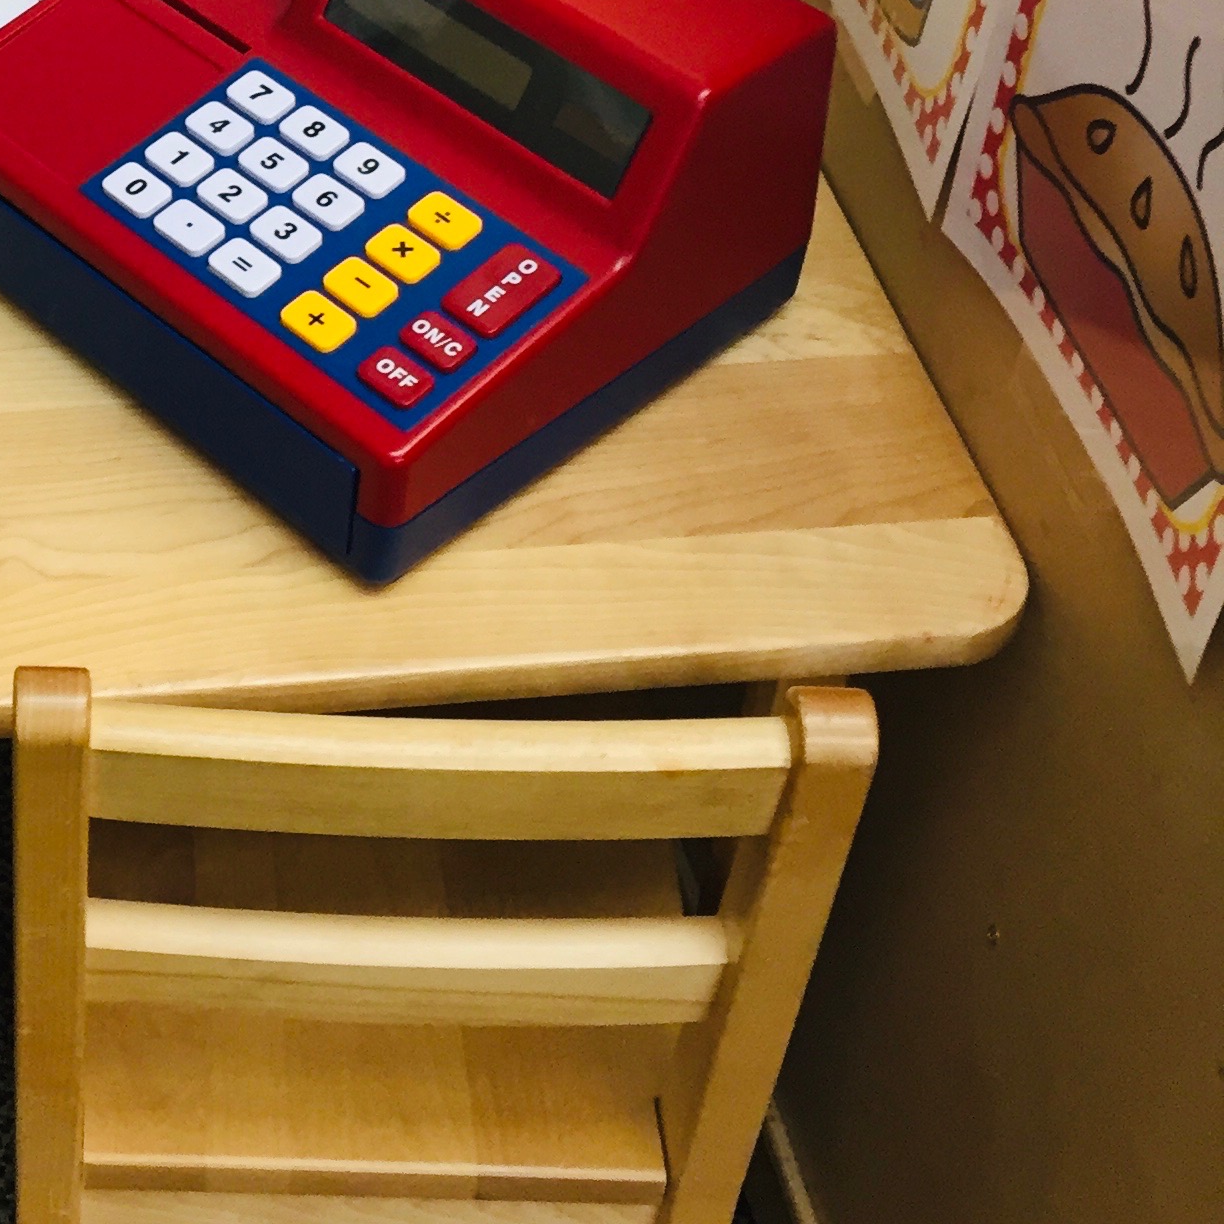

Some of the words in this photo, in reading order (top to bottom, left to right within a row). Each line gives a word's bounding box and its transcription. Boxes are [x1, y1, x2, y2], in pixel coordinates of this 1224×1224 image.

[249, 84, 274, 100] 7
[209, 119, 231, 134] 4
[302, 120, 326, 138] 8
[170, 150, 190, 165] 1
[260, 152, 285, 170] 5
[357, 158, 380, 175] 9
[125, 178, 148, 196] 0
[217, 184, 243, 203] 2
[315, 191, 339, 208] 6
[273, 222, 298, 240] 3
[466, 257, 539, 317] OPEN
[411, 318, 464, 358] ON/C
[375, 357, 420, 389] OFF
